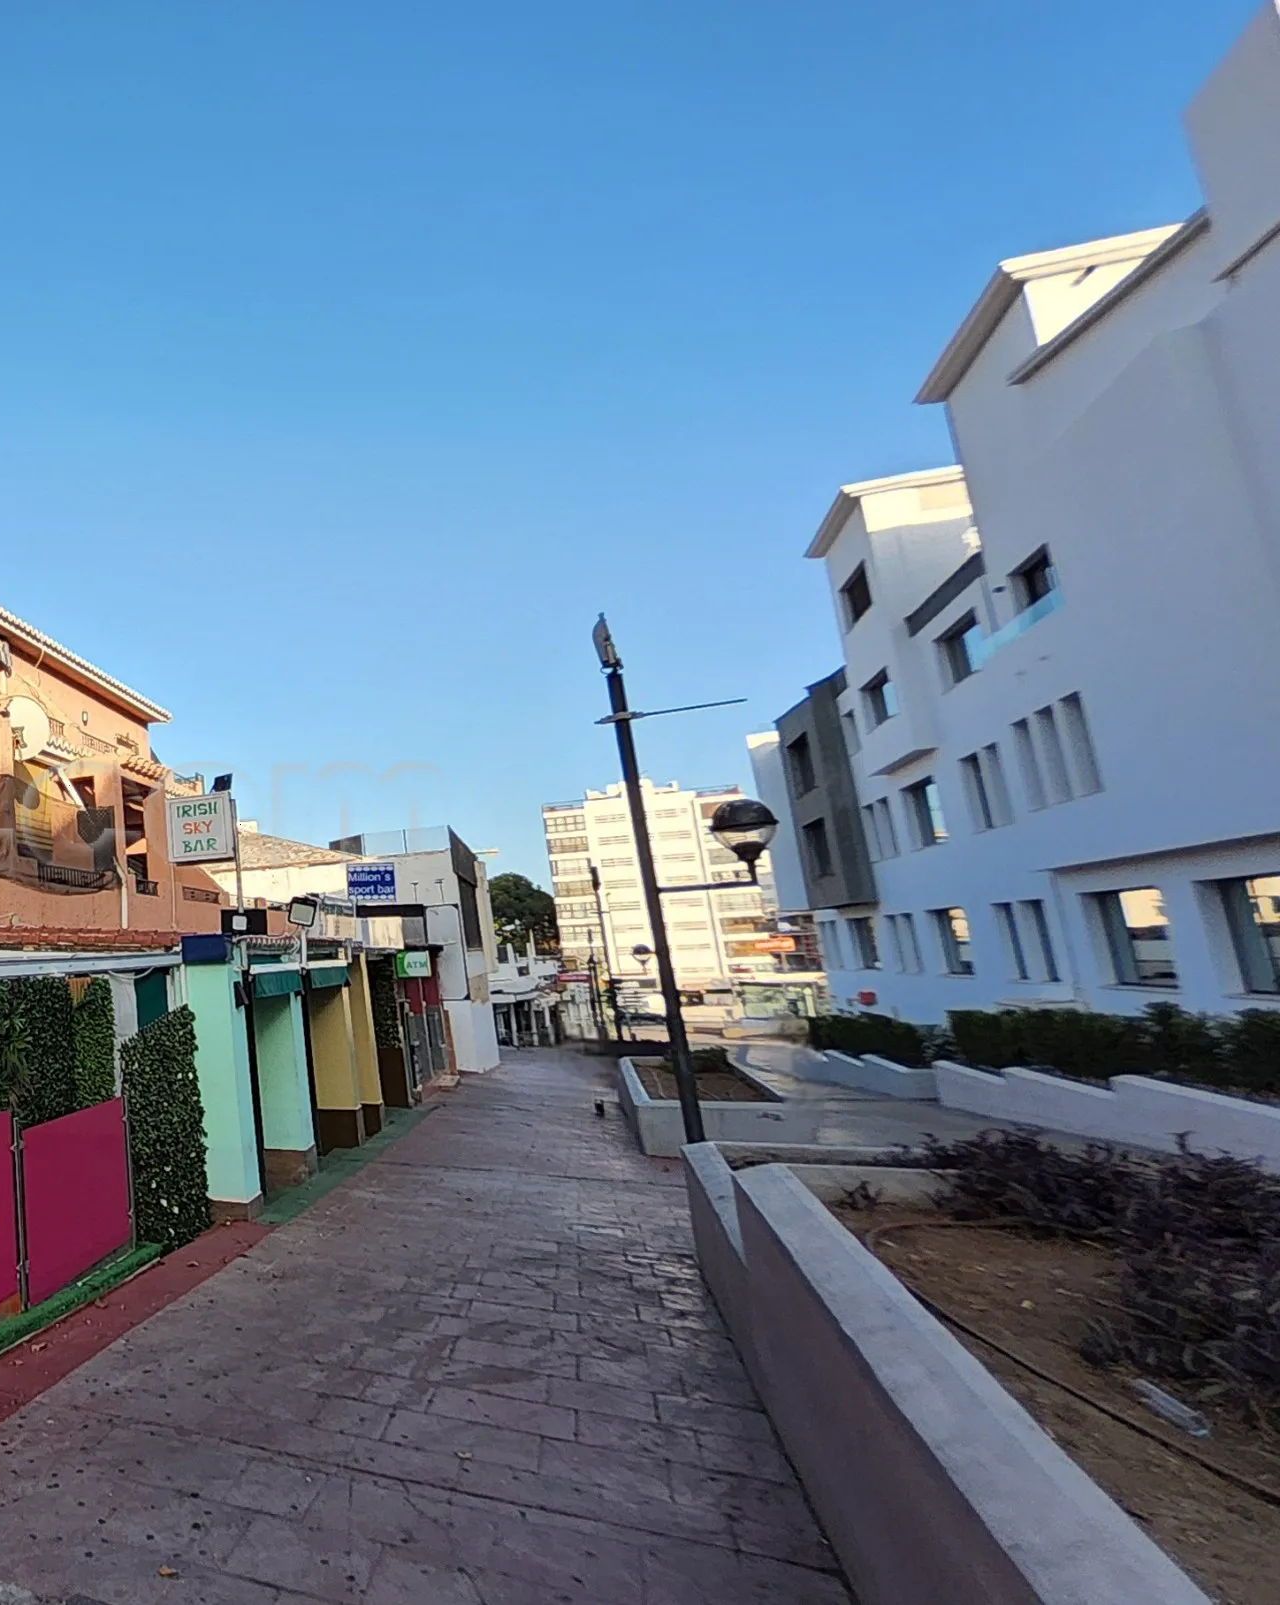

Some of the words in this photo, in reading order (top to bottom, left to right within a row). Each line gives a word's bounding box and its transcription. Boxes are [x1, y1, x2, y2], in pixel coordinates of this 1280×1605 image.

[176, 801, 218, 818] IRISH
[182, 820, 213, 835] SKY
[182, 838, 218, 853] BAR
[349, 885, 375, 895] sport
[377, 884, 395, 894] bar
